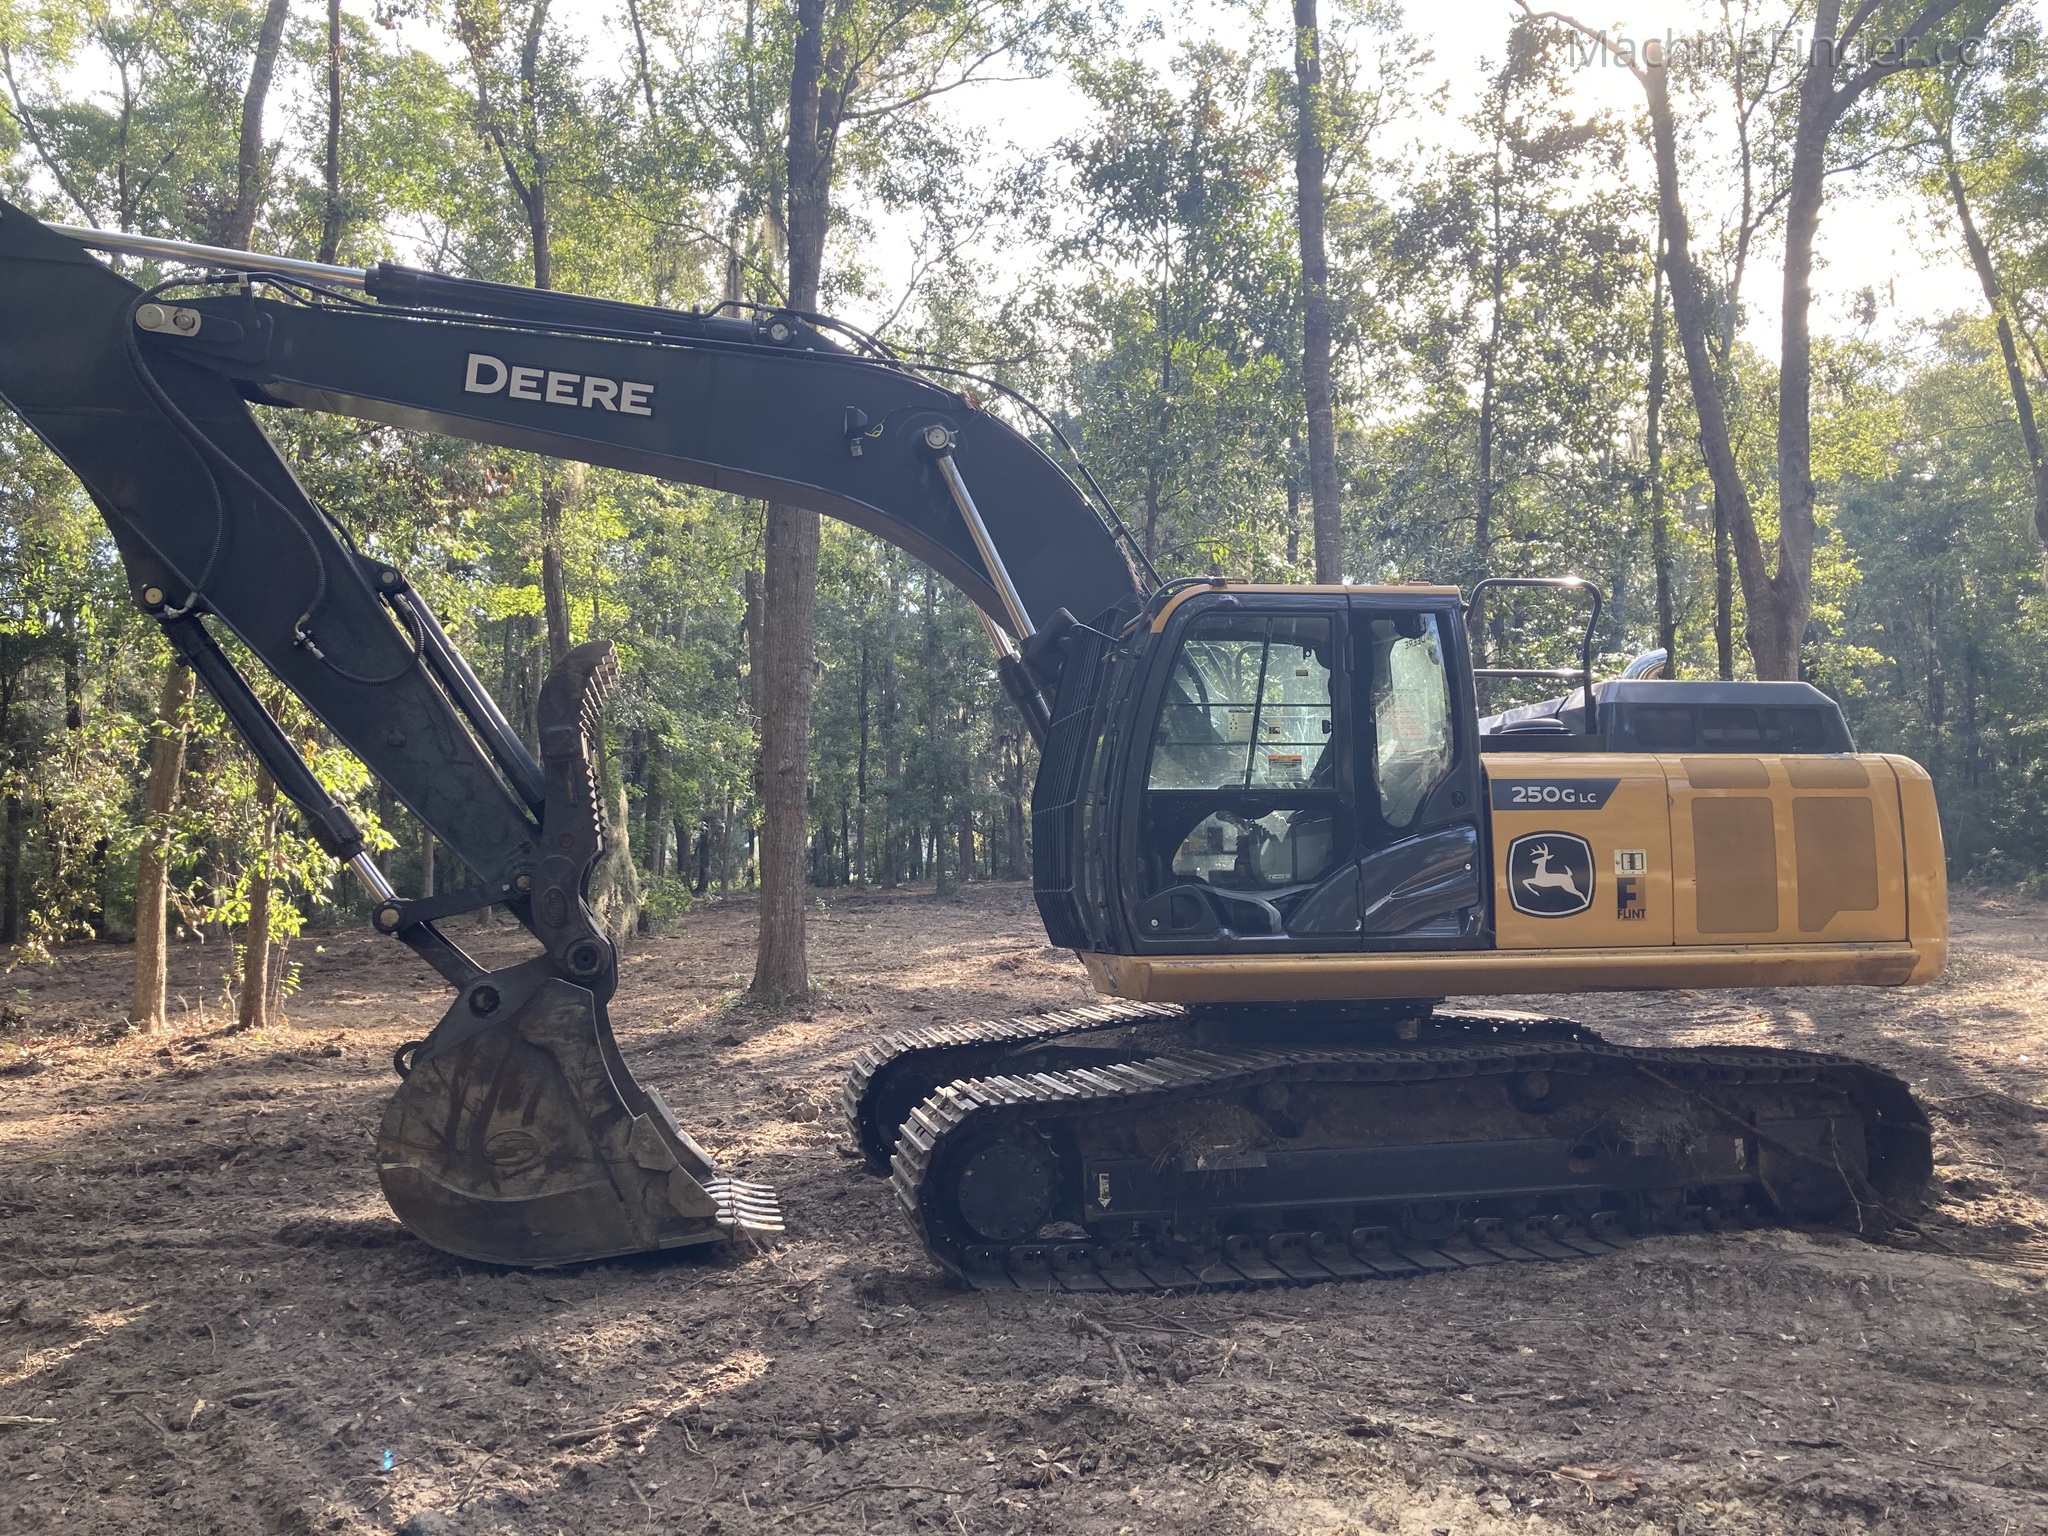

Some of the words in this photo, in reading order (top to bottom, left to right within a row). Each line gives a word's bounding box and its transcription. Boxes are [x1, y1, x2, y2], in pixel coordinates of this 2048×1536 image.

[464, 353, 655, 416] DEERE
[1511, 786, 1576, 803] 250G
[1579, 793, 1597, 803] LC
[1617, 908, 1647, 920] FLINT
